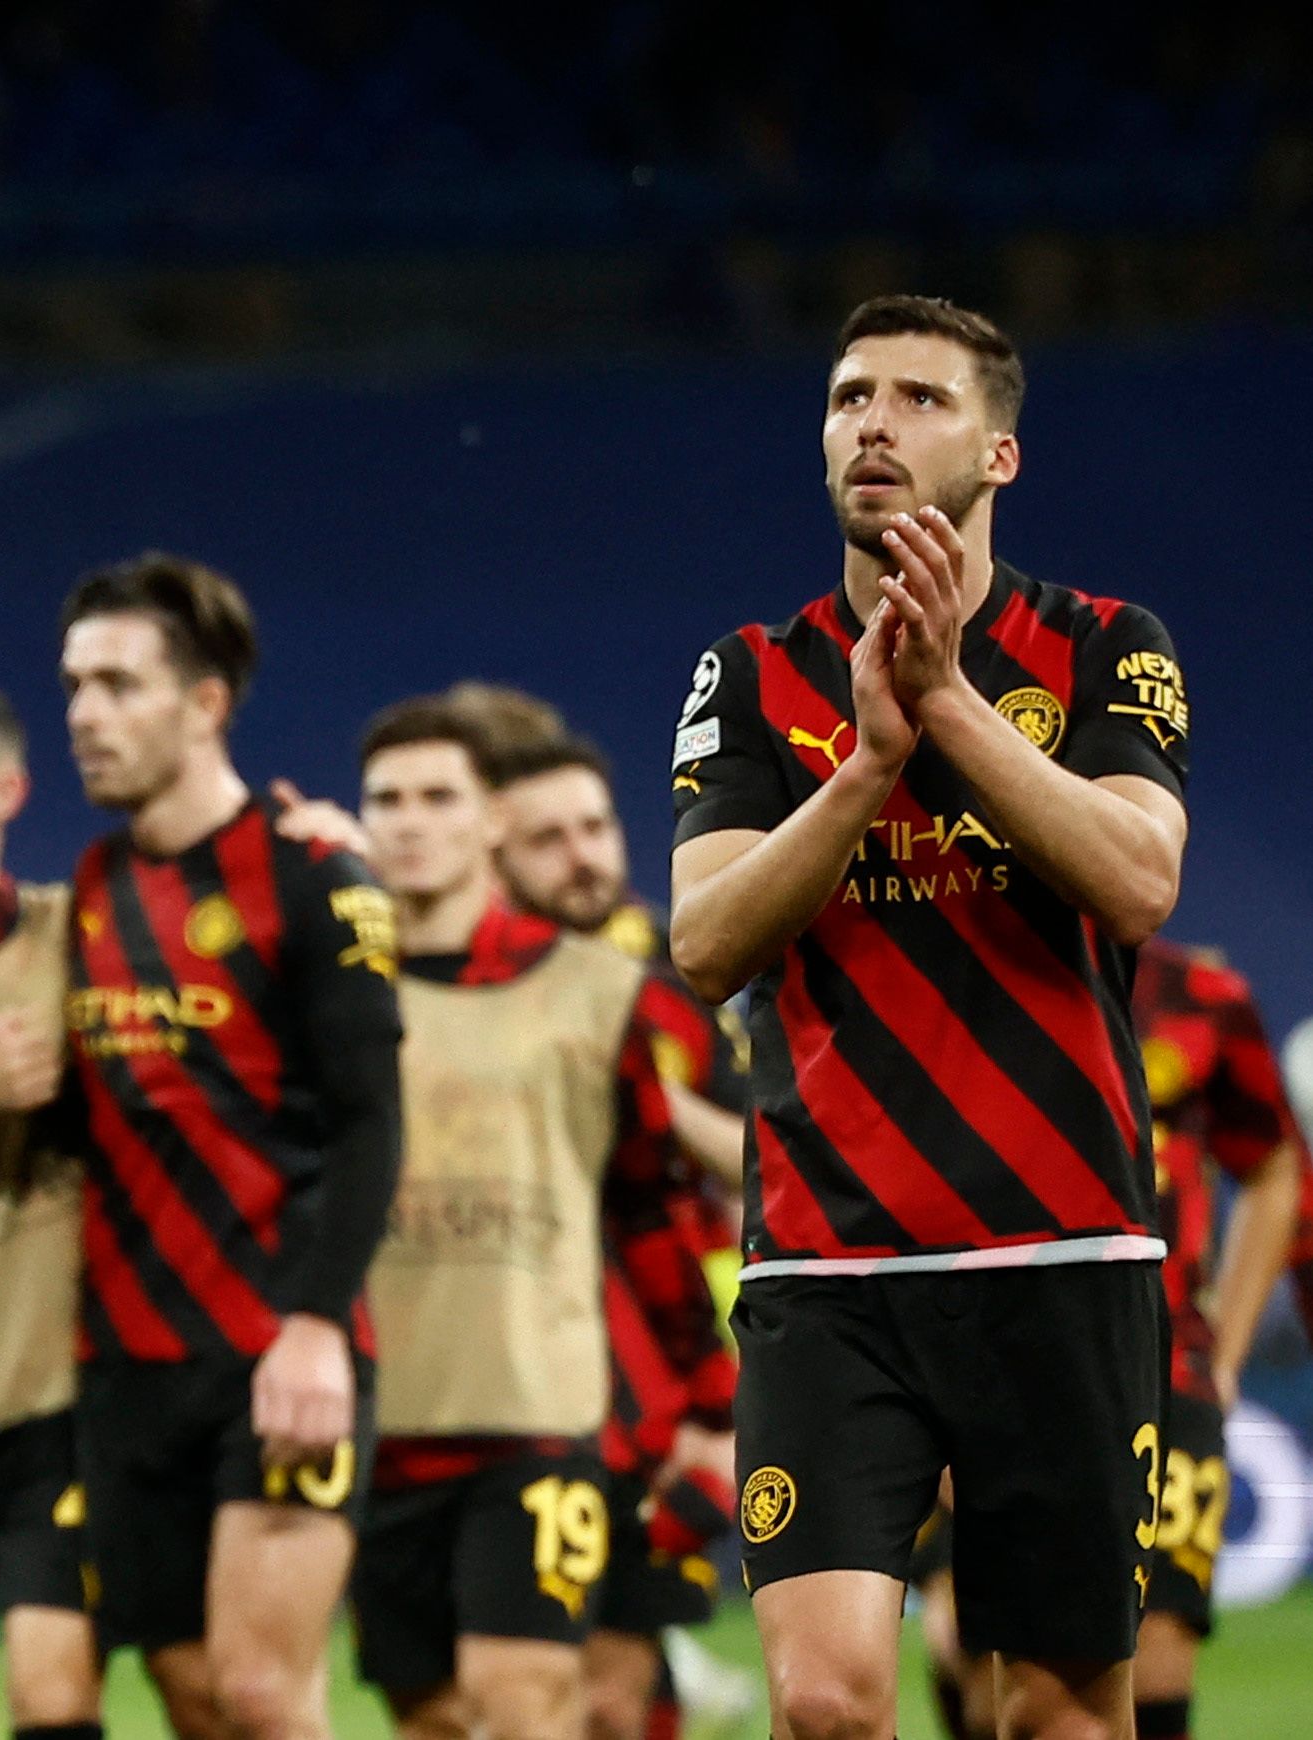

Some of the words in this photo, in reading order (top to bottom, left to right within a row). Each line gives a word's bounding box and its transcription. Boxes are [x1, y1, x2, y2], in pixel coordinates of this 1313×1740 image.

[842, 864, 1008, 904] AIRWAYS
[521, 1475, 609, 1583] 19
[1131, 1422, 1159, 1550] 3
